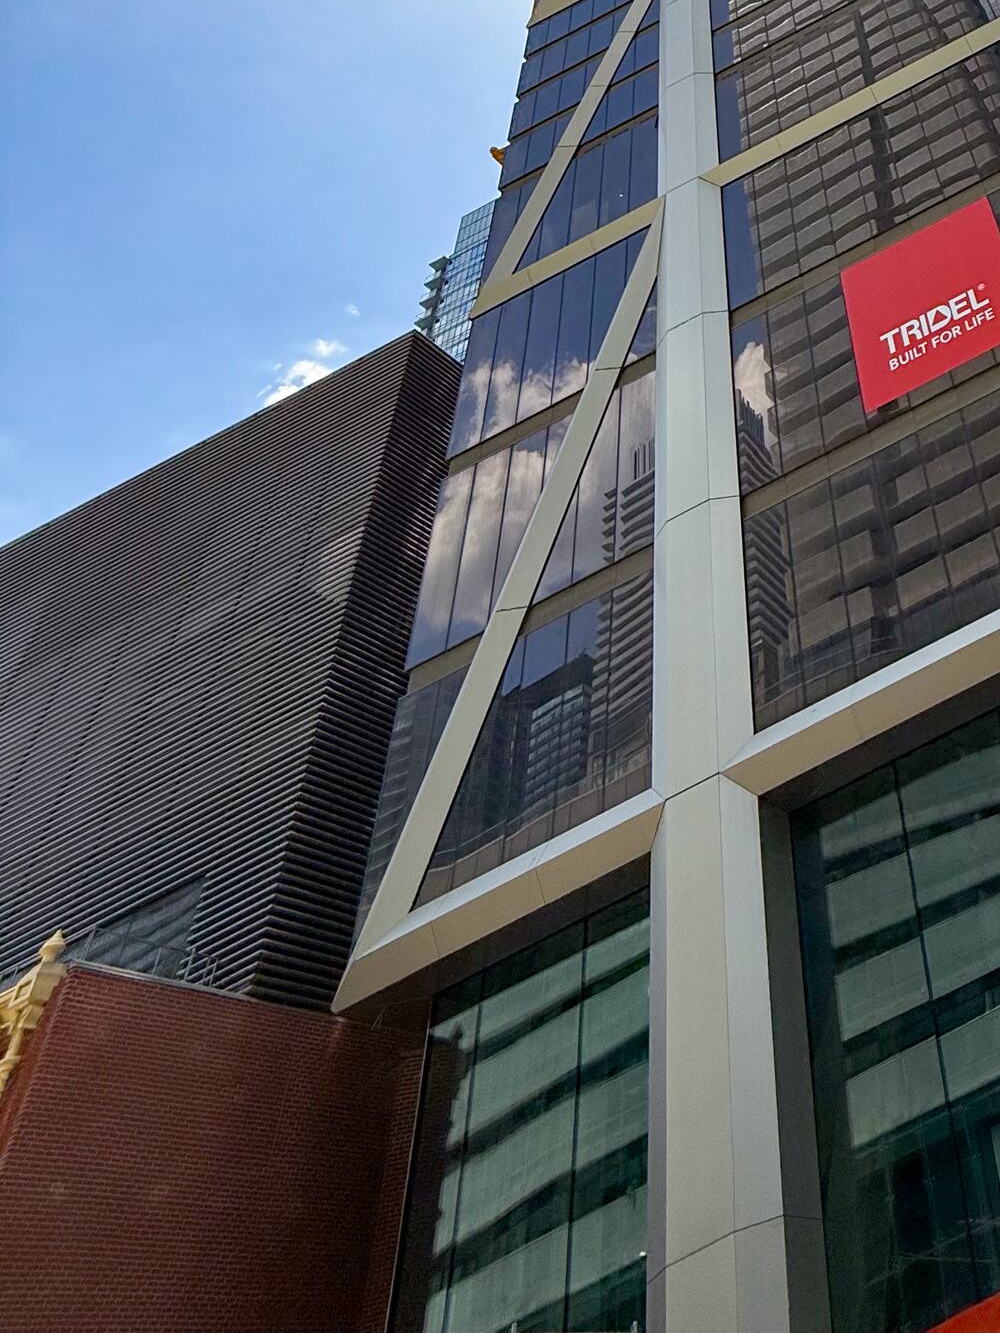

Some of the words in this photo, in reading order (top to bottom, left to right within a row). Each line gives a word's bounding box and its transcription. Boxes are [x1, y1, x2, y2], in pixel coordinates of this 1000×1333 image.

[888, 341, 928, 372] BUILT
[931, 325, 962, 349] FOR
[964, 307, 995, 332] LIFE
